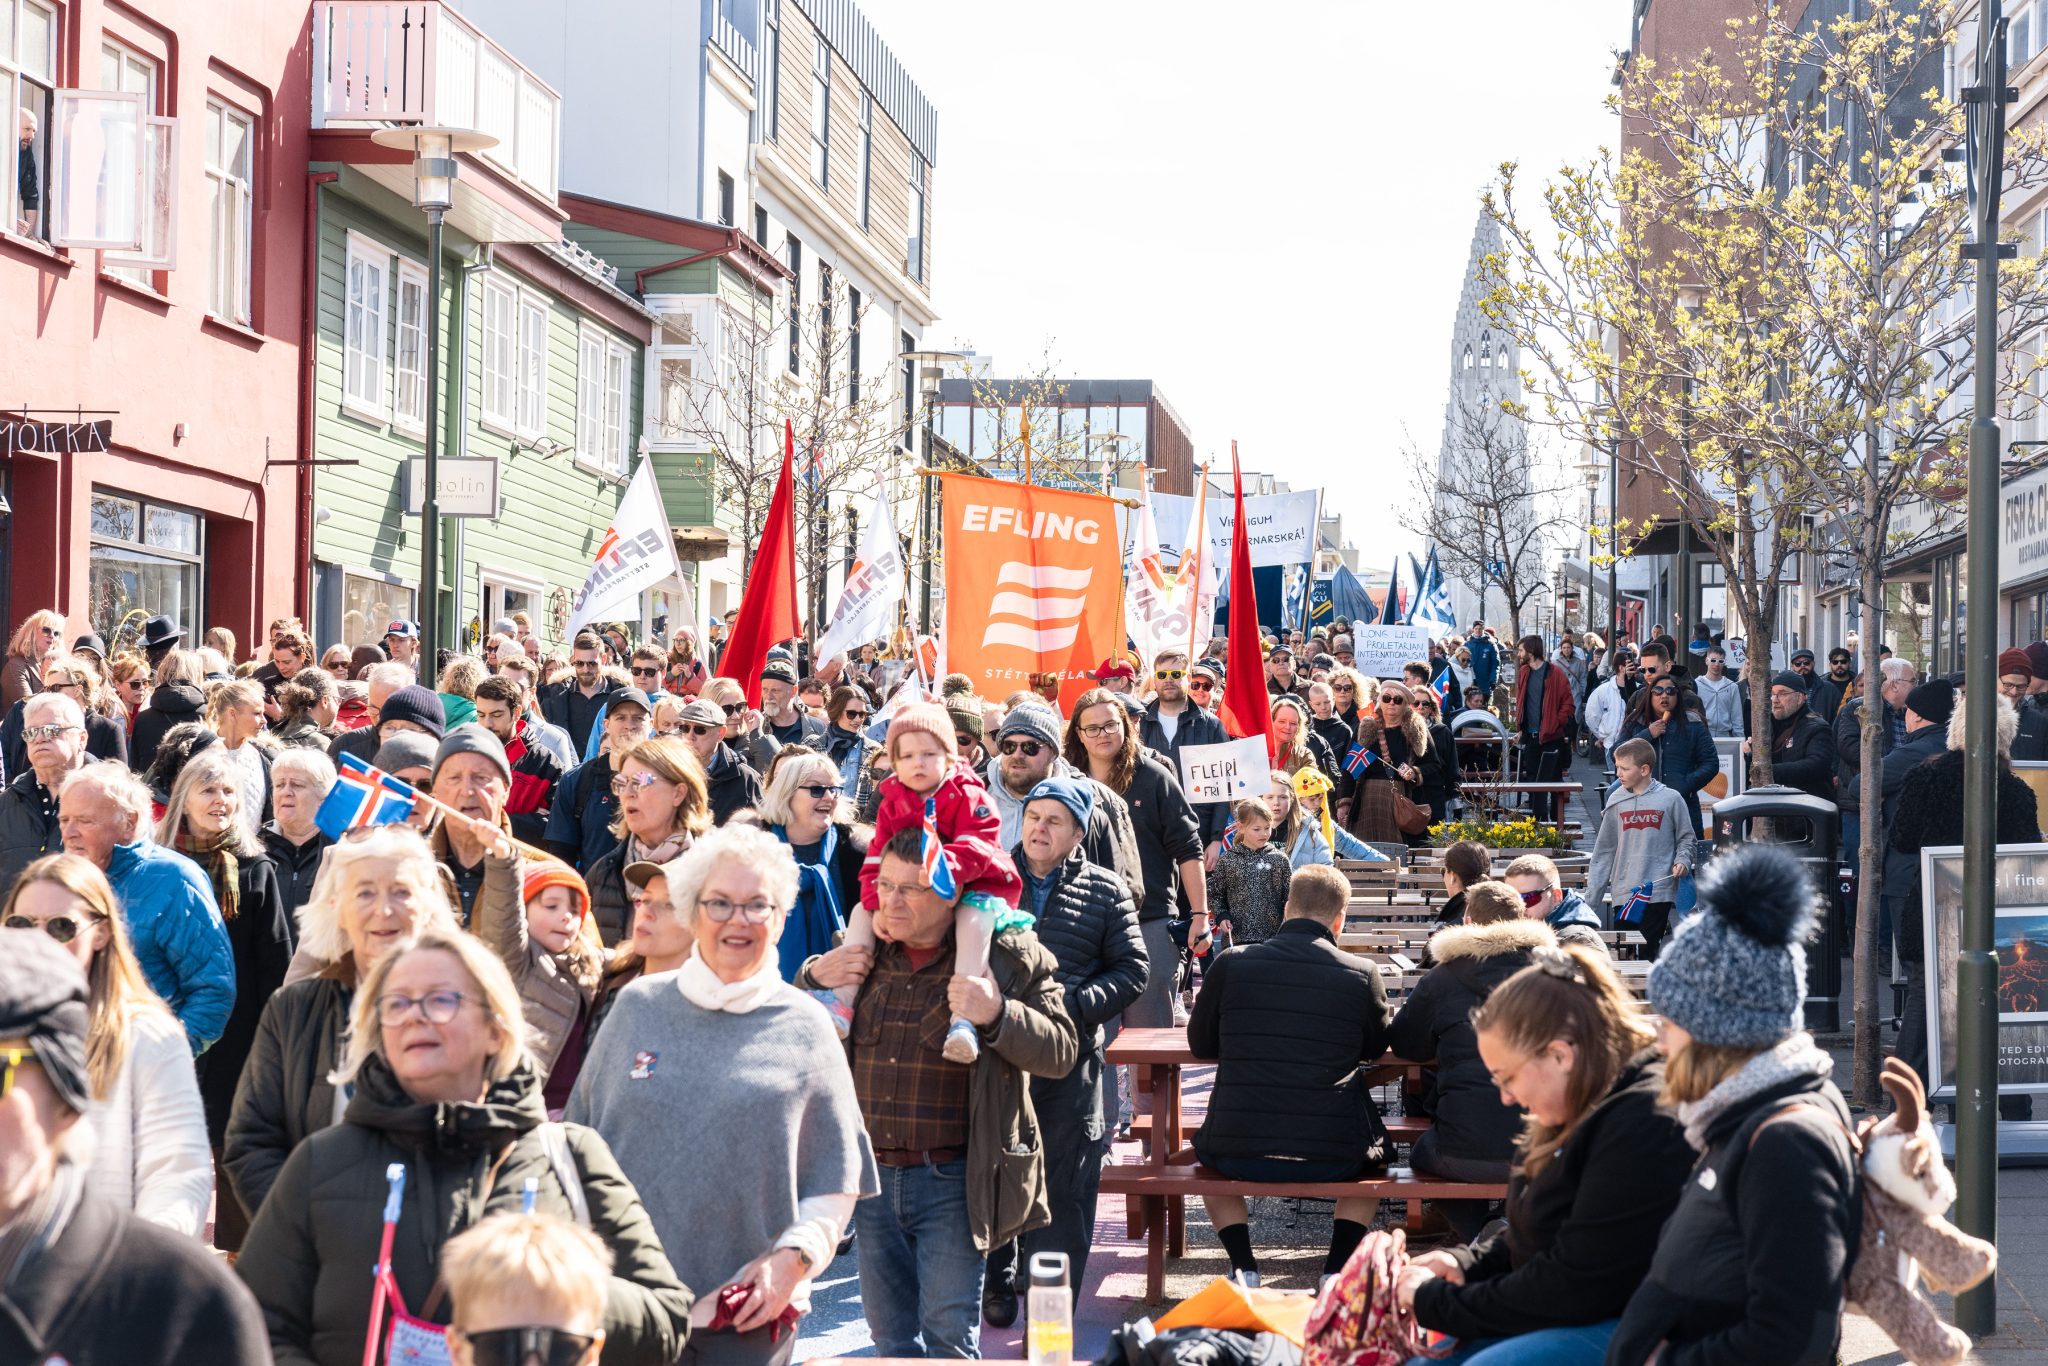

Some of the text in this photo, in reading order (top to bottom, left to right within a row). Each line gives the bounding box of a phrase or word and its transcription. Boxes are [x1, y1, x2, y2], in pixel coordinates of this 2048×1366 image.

[0, 421, 107, 458] MOKKA
[962, 504, 1100, 545] EFLING
[1247, 515, 1273, 526] IGUM
[2005, 492, 2026, 545] FISH
[2027, 491, 2036, 536] &
[1221, 526, 1305, 547] STRNARSKRÁ!
[1360, 629, 1417, 639] LONG LIVE
[1366, 640, 1424, 651] PROLETARIAN
[985, 667, 1097, 682] STÉTTÉLA
[2015, 873, 2046, 887] fine
[2027, 1045, 2048, 1054] EDI
[1998, 1057, 2048, 1066] OTOGRA
